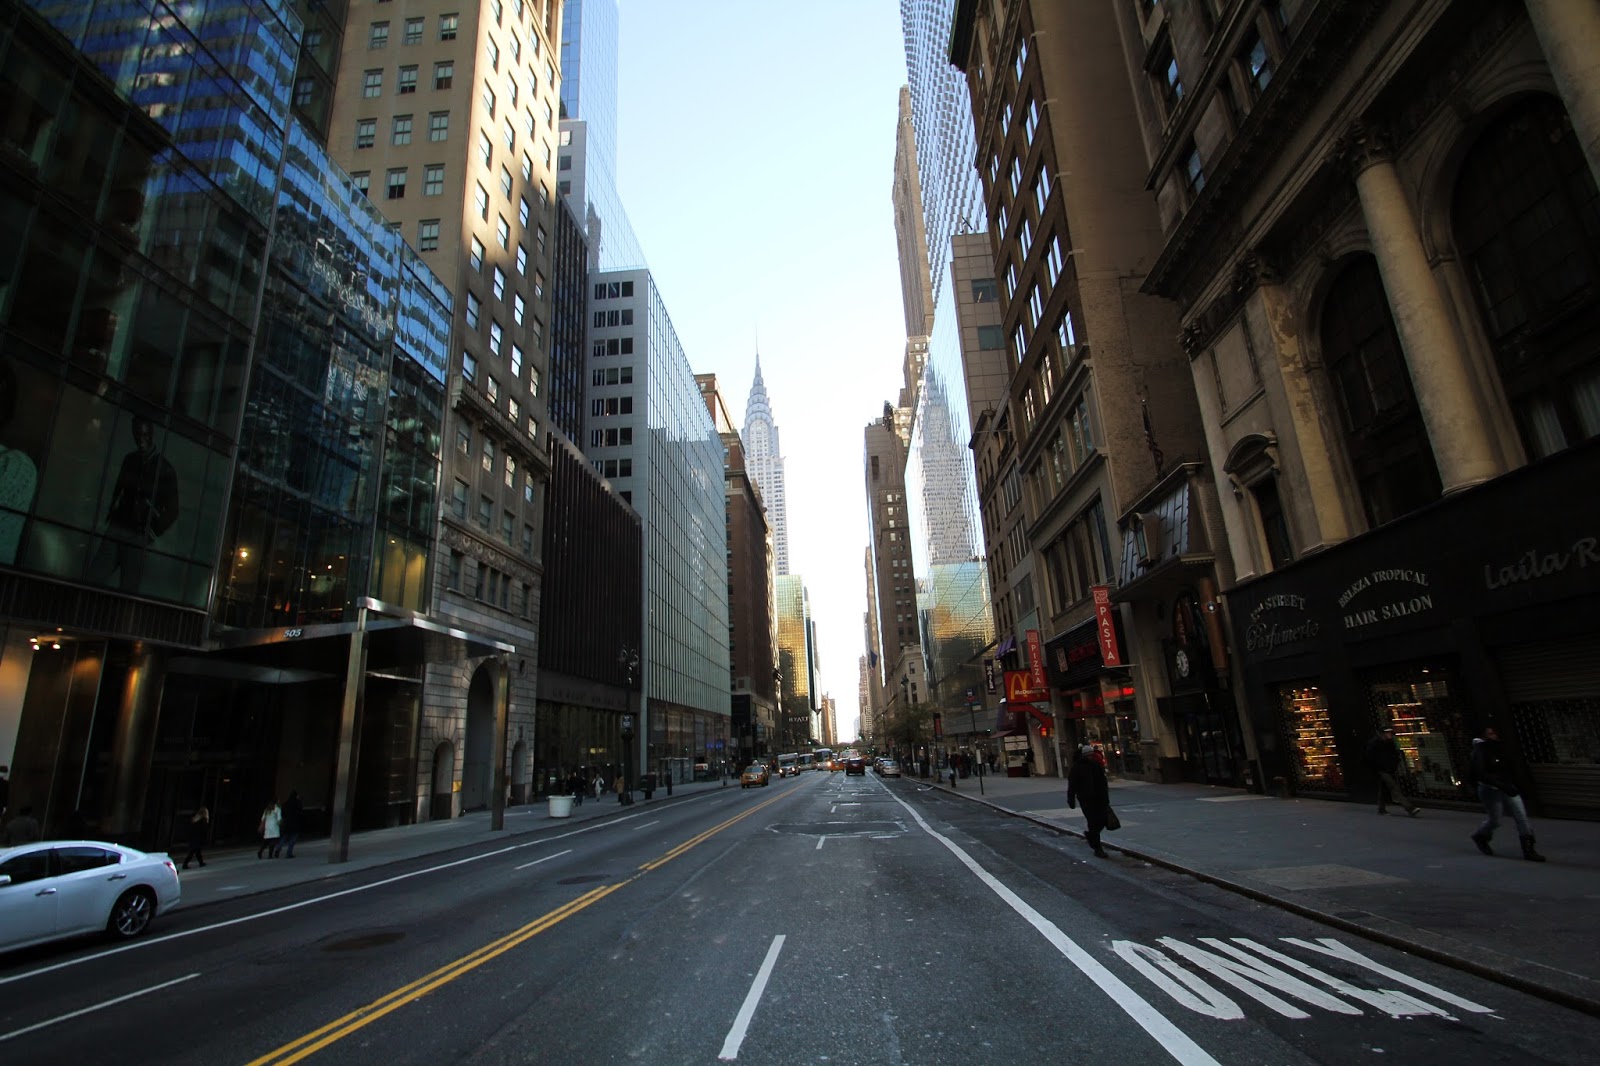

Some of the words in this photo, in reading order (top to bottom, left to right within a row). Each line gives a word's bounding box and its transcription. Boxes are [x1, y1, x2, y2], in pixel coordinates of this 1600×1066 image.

[1371, 569, 1429, 587] TROPICAL
[1482, 549, 1570, 589] Laila
[1264, 594, 1305, 610] STREET
[1343, 609, 1378, 629] HAIR
[1381, 594, 1433, 620] SALON
[283, 628, 302, 638] 505
[1099, 606, 1116, 660] PASTA
[985, 664, 995, 690] NAILS
[1031, 644, 1041, 684] PIZZA
[1014, 688, 1046, 696] McDons
[1111, 936, 1504, 1021] ONLY
